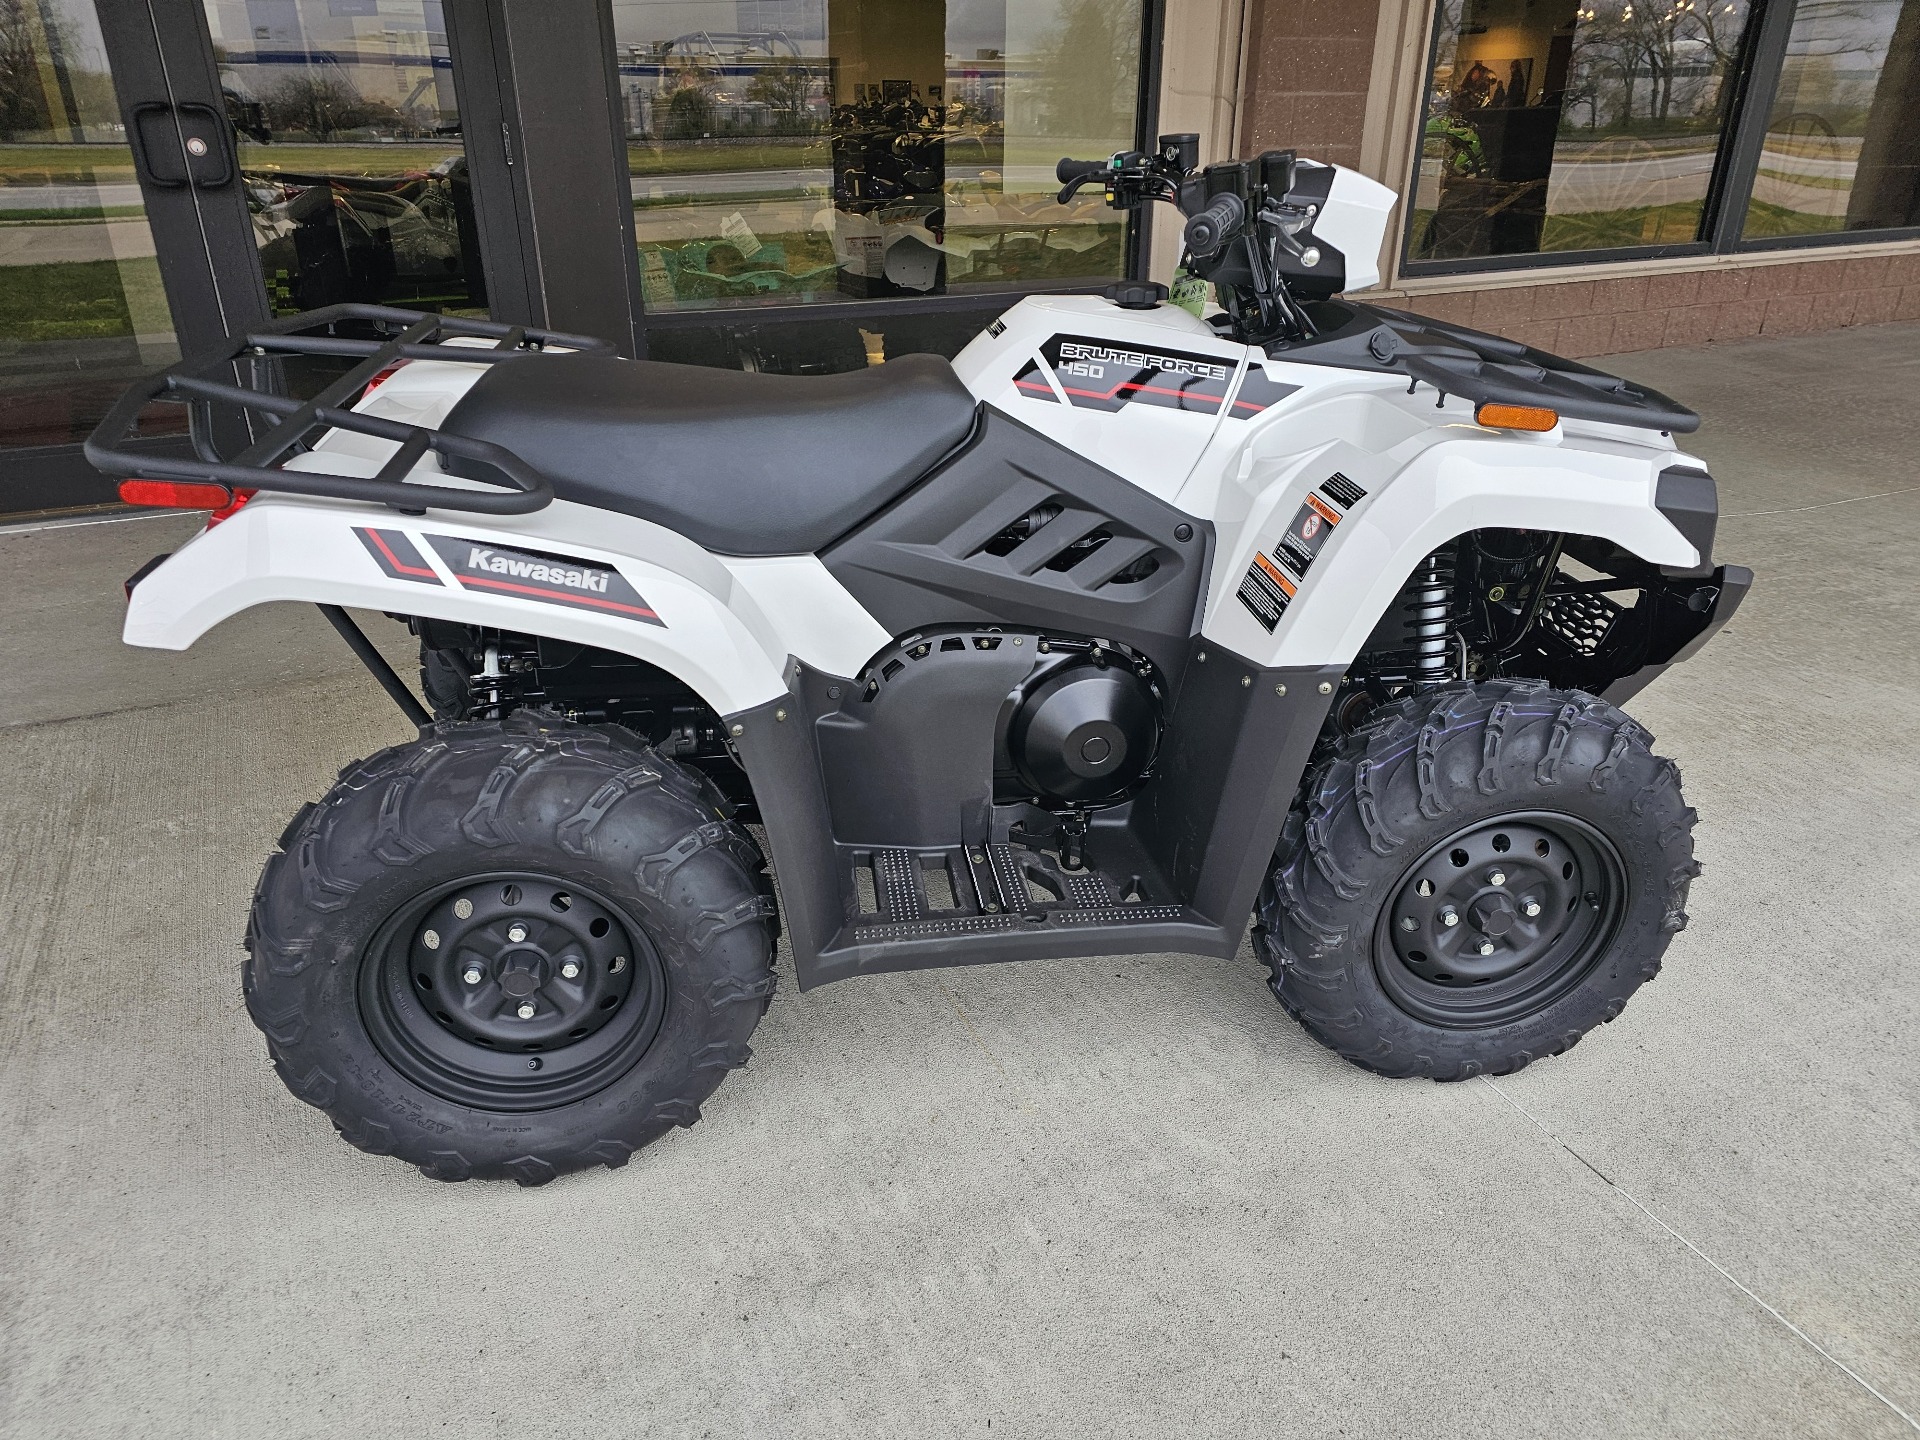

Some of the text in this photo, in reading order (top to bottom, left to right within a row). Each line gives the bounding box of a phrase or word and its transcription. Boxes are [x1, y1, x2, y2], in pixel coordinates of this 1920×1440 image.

[1058, 361, 1104, 379] 450
[1060, 342, 1226, 380] BRUTE FORCE
[1315, 501, 1336, 521] WARNING
[468, 547, 609, 593] Kawasaki
[1268, 567, 1285, 586] WARNING
